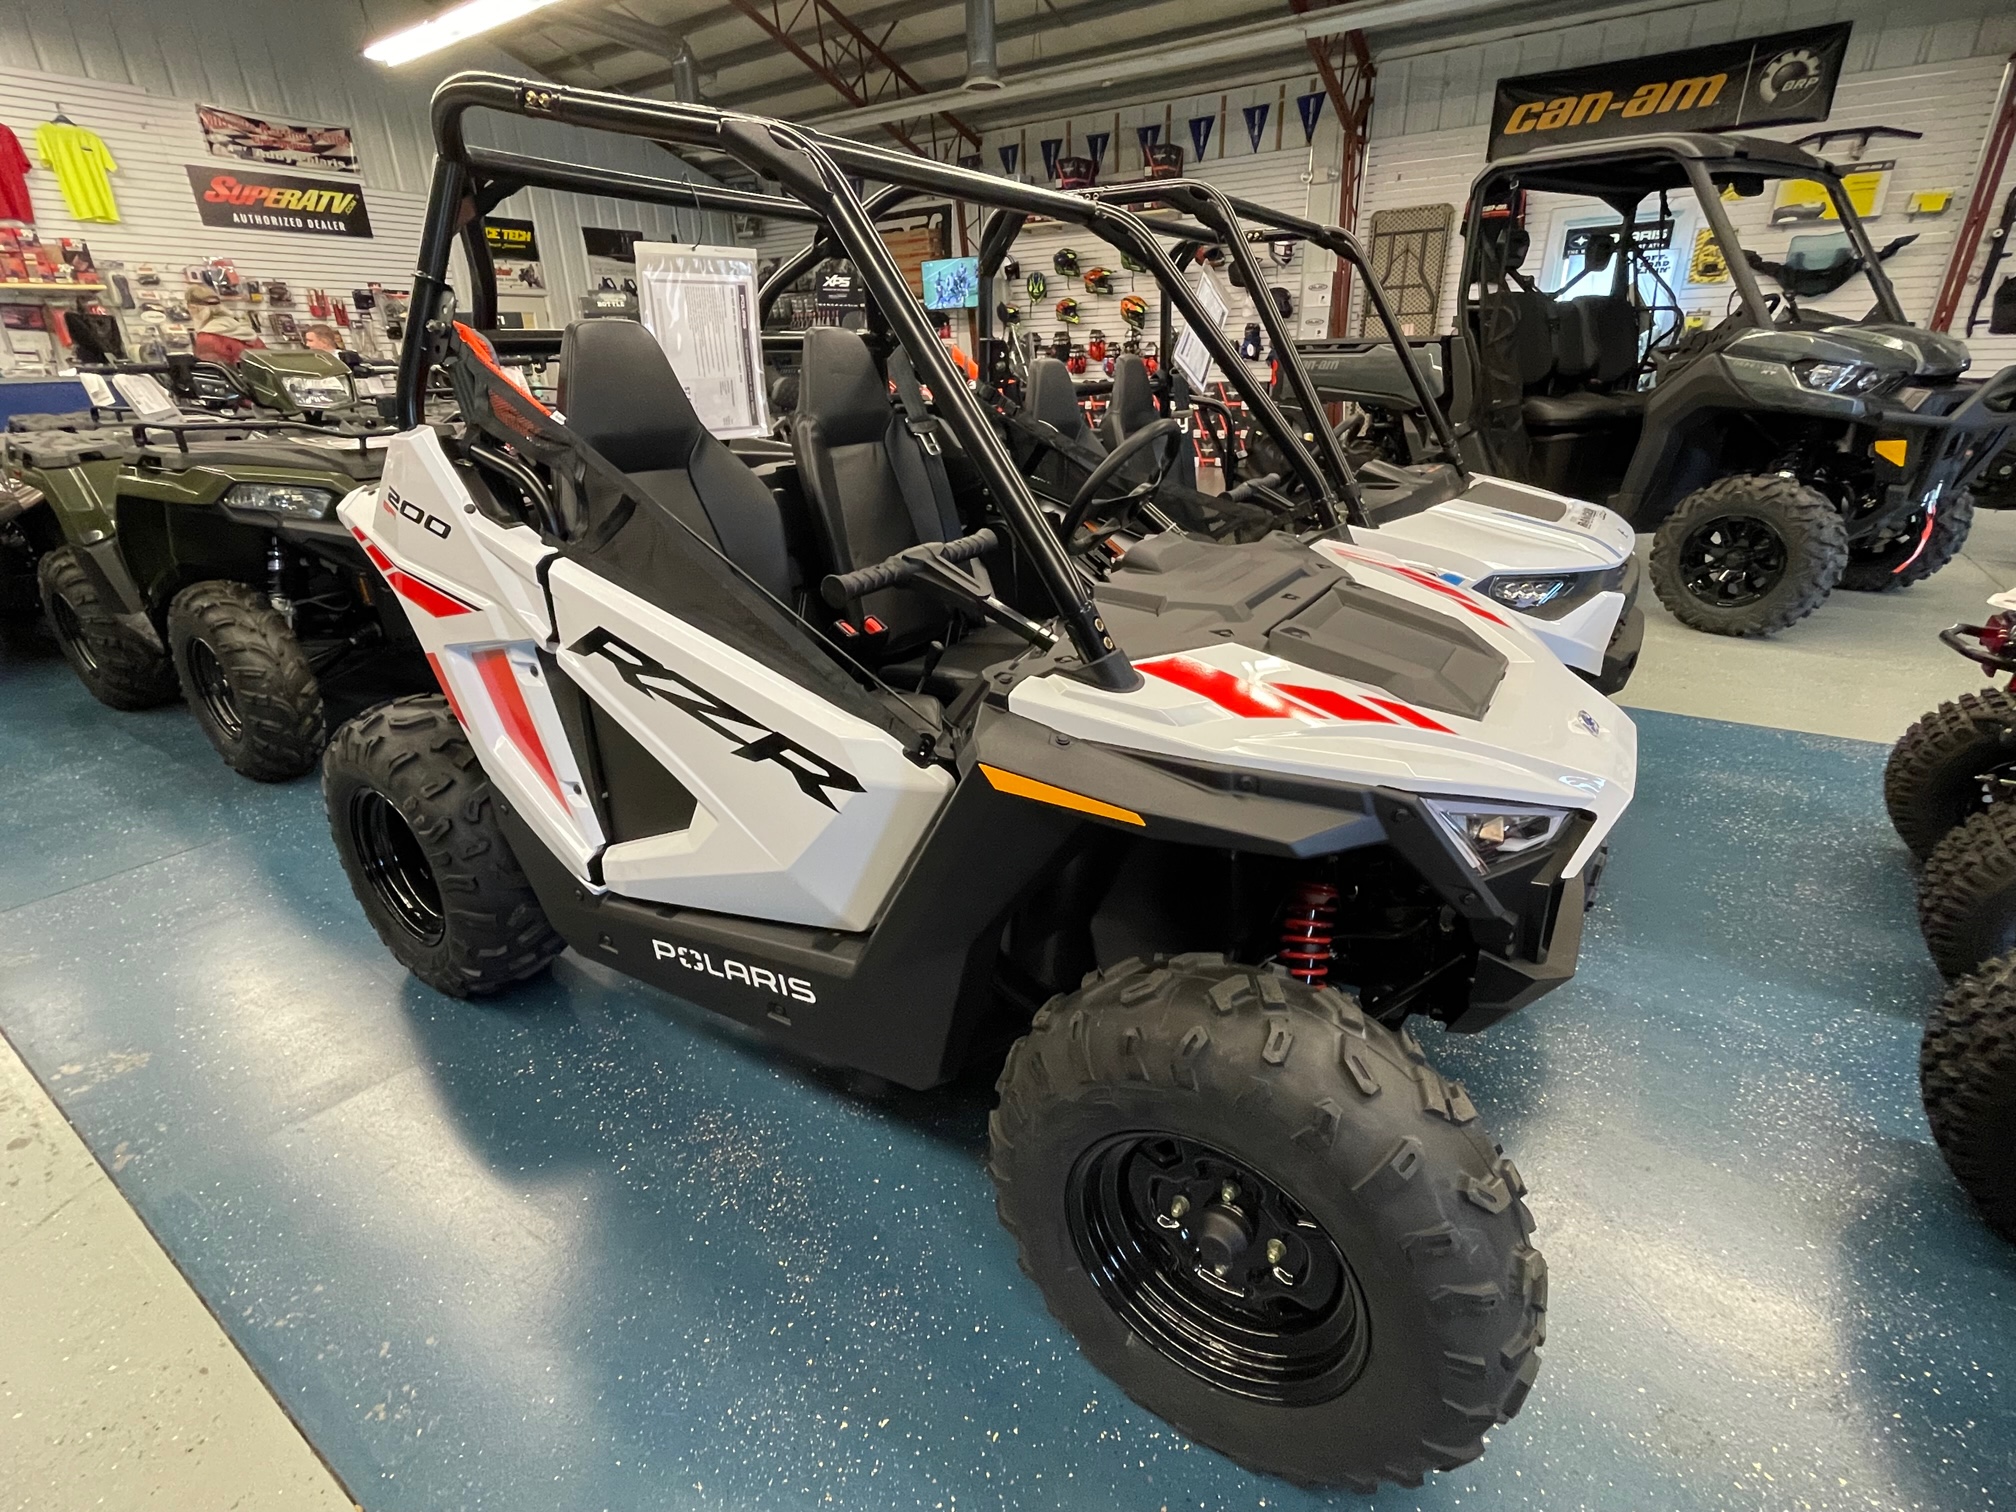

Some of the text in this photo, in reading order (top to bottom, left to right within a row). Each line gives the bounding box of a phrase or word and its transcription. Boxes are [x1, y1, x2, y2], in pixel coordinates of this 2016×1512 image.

[1781, 76, 1819, 92] BRP
[1504, 73, 1727, 135] can-am
[233, 212, 347, 232] AUTHORIZED DEALER
[502, 229, 532, 242] TECH
[822, 274, 852, 288] XPS
[388, 485, 452, 540] 200
[565, 625, 869, 815] RZR
[651, 938, 817, 1004] POLARIS
